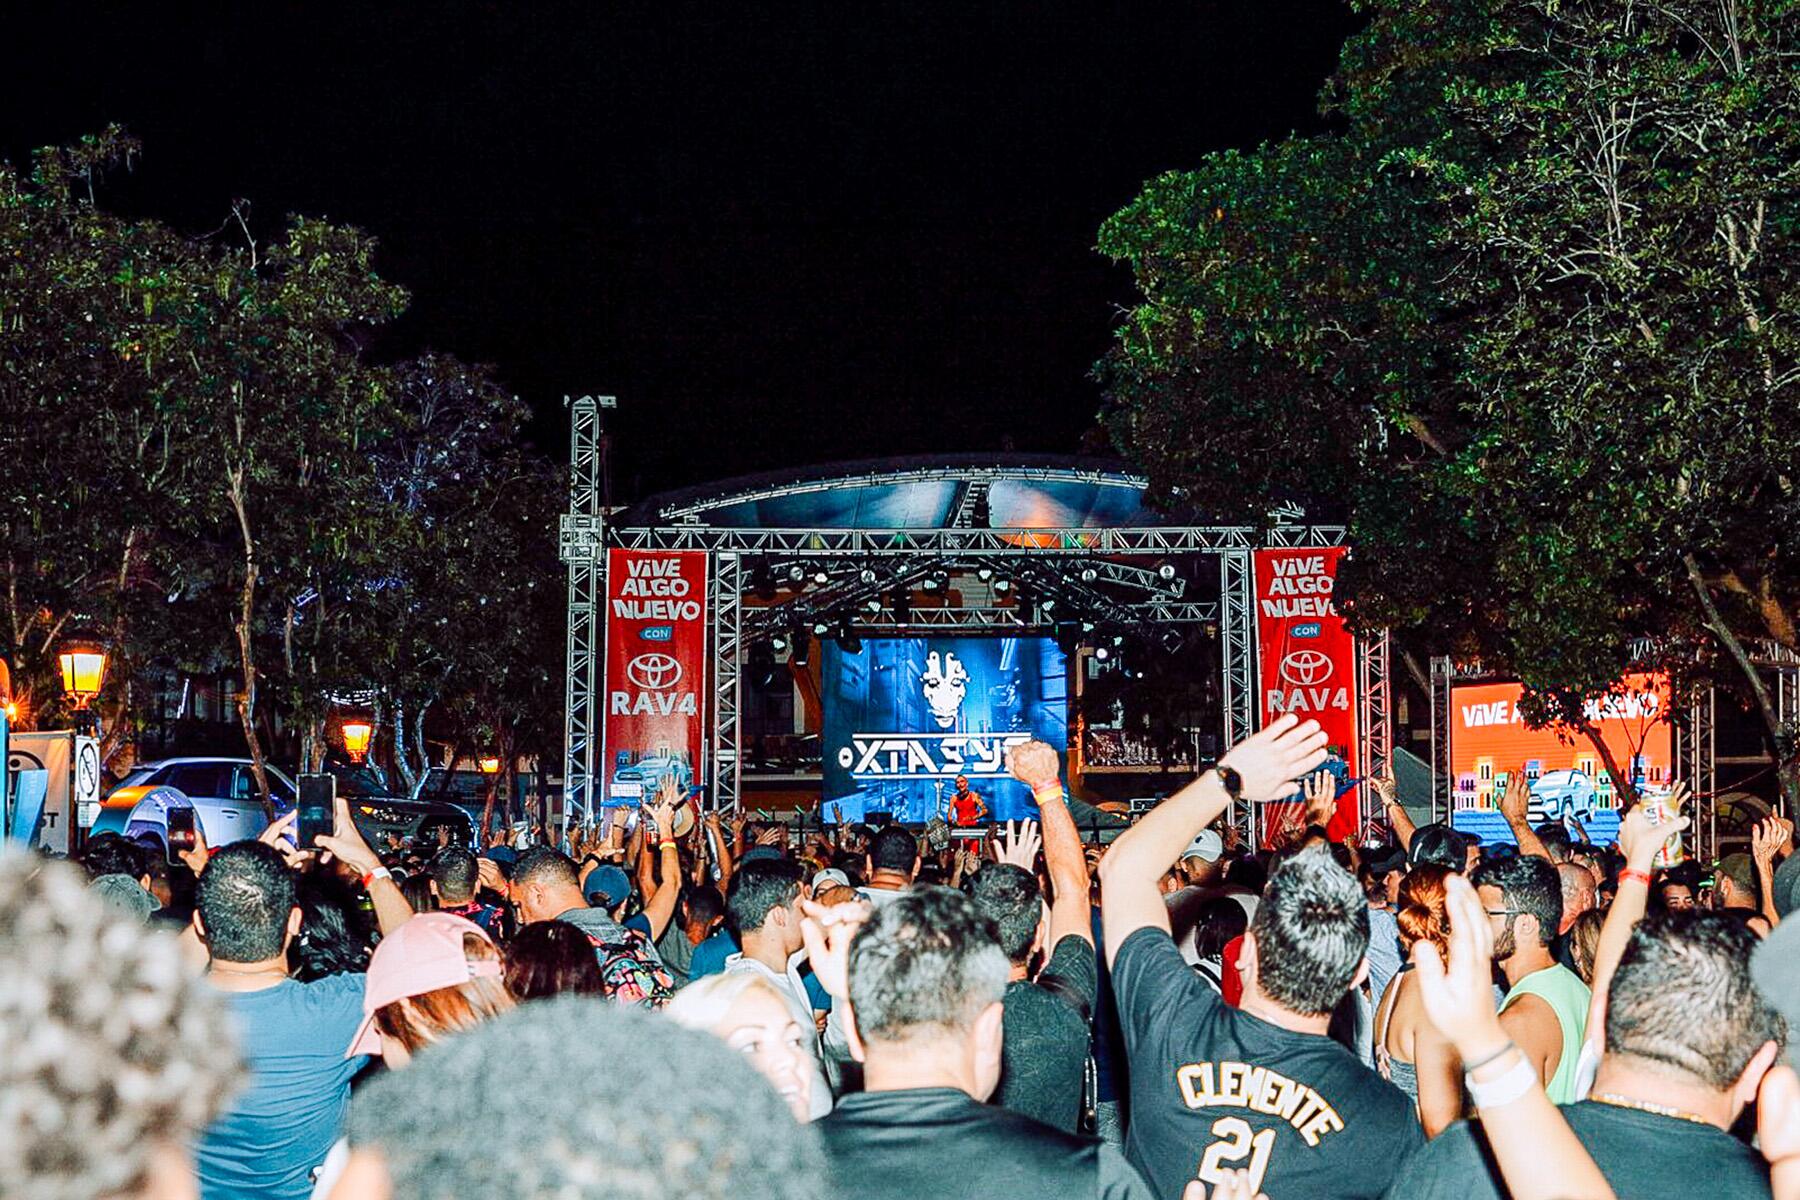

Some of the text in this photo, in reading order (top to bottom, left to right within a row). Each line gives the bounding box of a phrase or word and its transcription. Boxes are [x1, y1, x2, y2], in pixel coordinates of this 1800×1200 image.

[621, 578, 689, 597] ALGO
[1268, 576, 1334, 596] ALGO
[612, 599, 701, 621] NUEVO
[644, 629, 668, 639] CON
[1294, 626, 1318, 636] CON
[611, 691, 697, 717] RAV4
[1267, 687, 1349, 713] RAV4
[1176, 1061, 1345, 1147] CLEMENTE
[1199, 1116, 1277, 1197] 21
